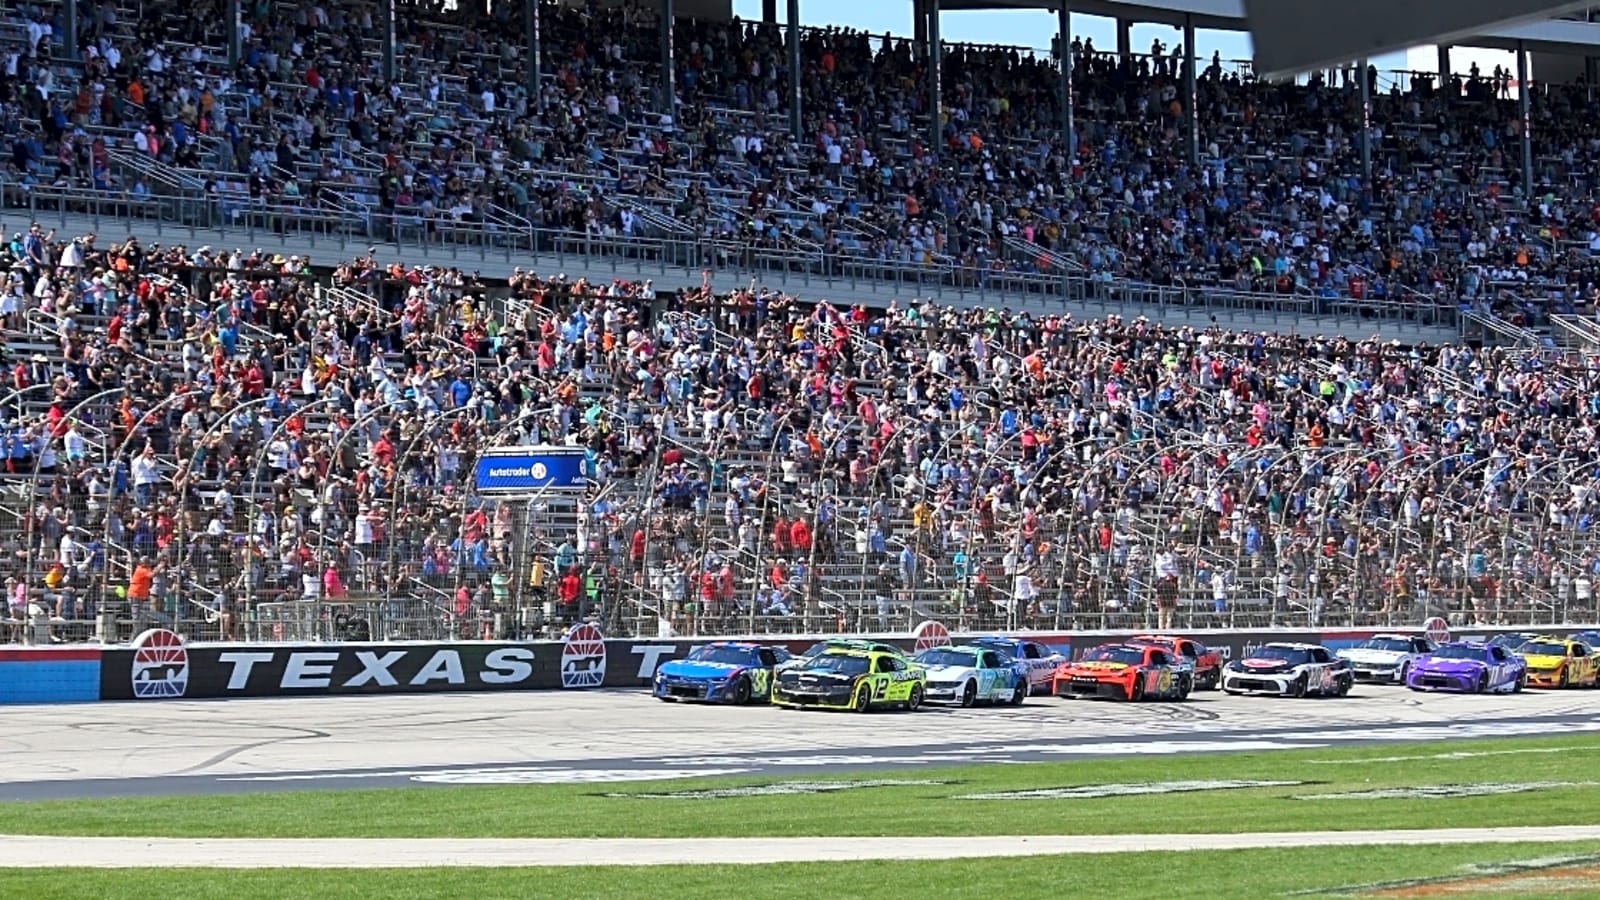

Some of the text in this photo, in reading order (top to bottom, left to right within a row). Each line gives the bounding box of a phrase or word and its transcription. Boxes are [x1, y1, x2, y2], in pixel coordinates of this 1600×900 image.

[490, 467, 530, 477] Autotrader
[218, 648, 534, 689] TEXAS
[873, 678, 889, 699] 12
